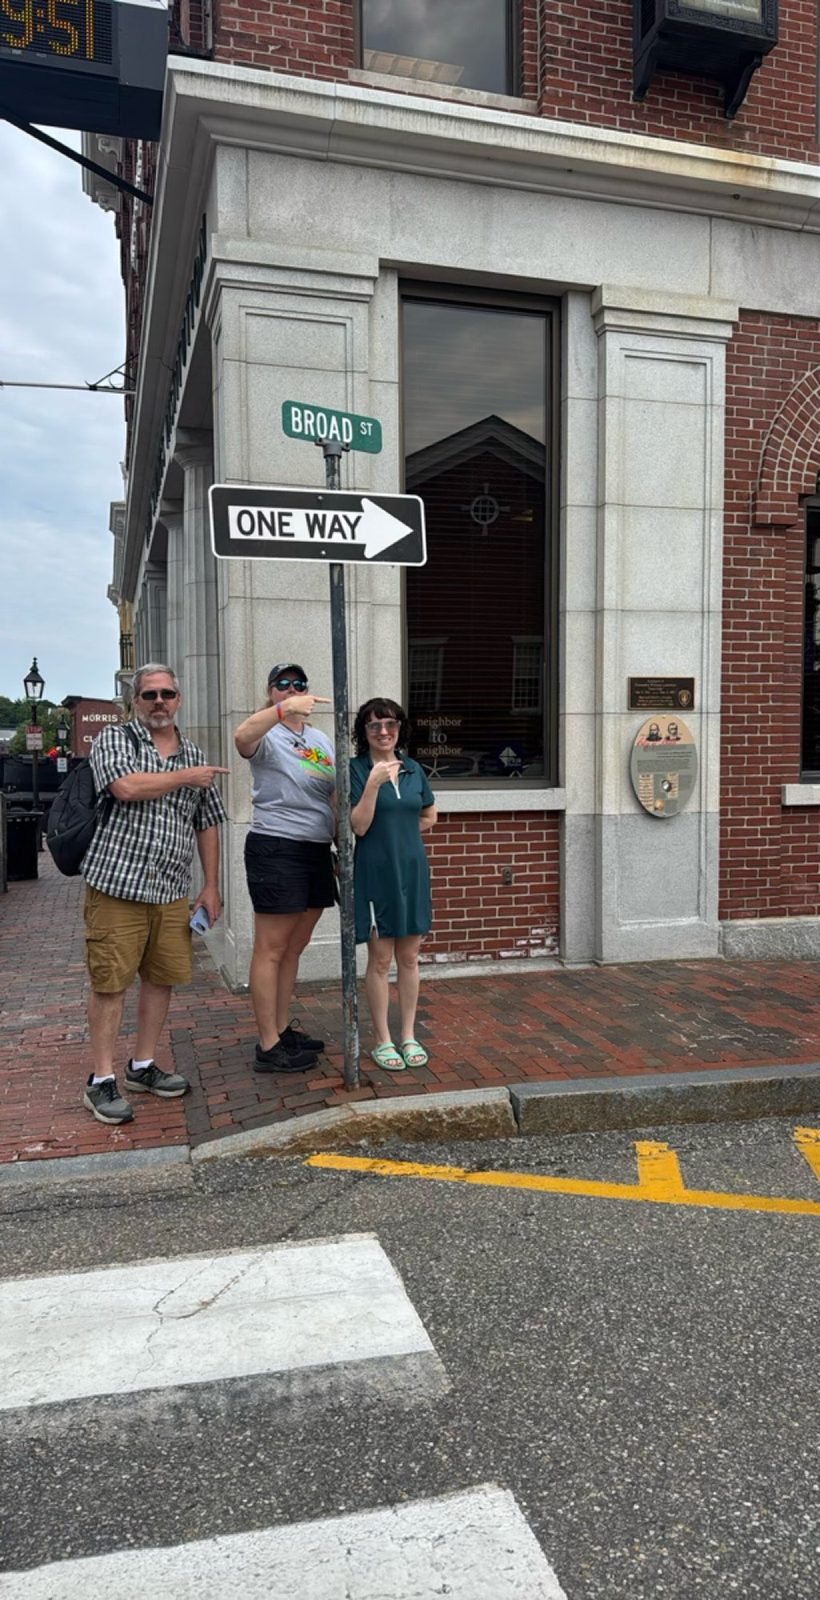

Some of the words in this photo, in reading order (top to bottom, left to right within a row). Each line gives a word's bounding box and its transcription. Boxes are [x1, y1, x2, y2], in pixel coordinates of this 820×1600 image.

[2, 0, 95, 59] 9:51
[291, 406, 353, 443] BROAD
[360, 422, 373, 436] ST
[237, 509, 295, 537] ONE
[305, 513, 362, 540] WAY
[82, 714, 118, 722] MORRIS
[417, 717, 462, 729] neighbor
[432, 730, 447, 743] to
[417, 745, 462, 757] neighbor
